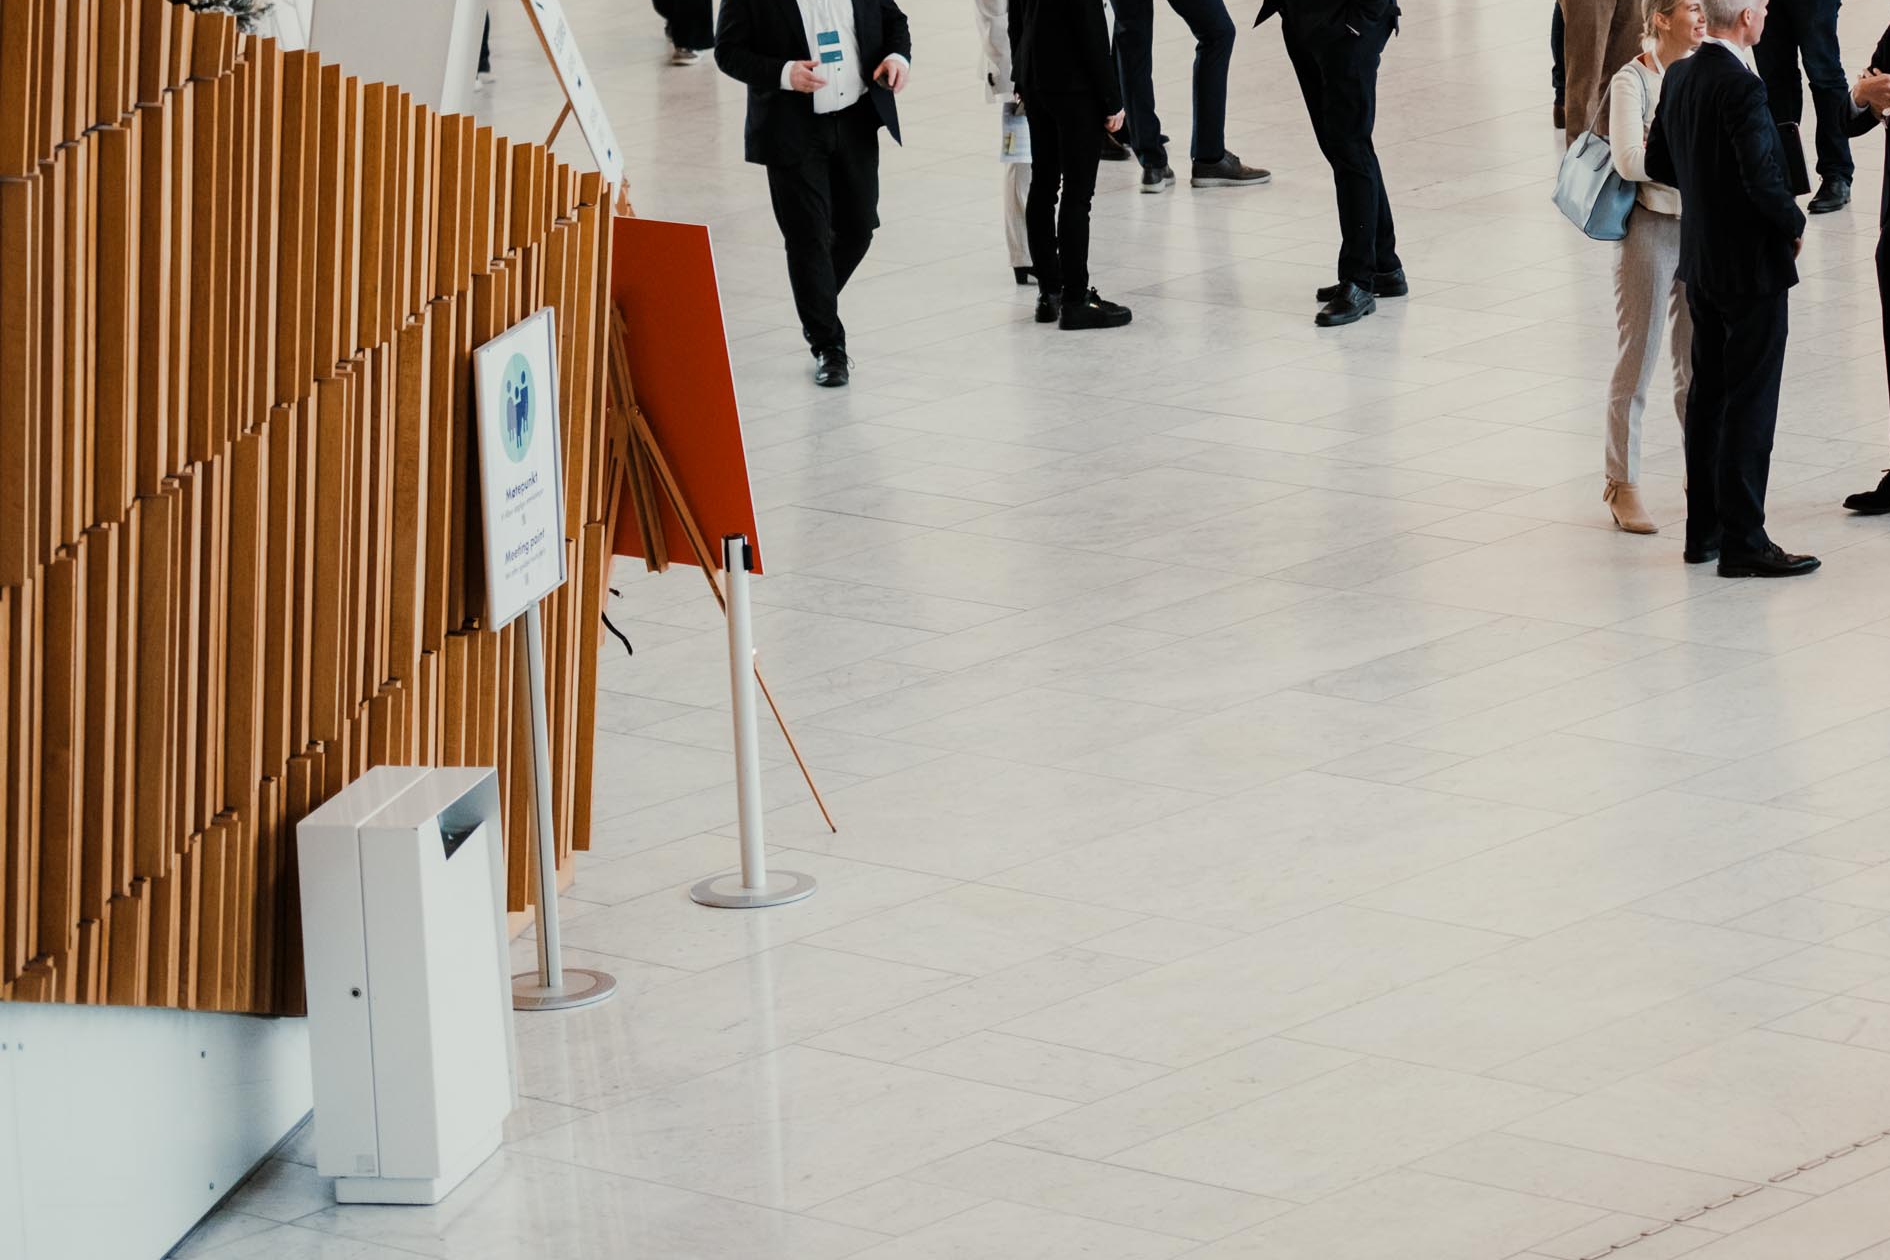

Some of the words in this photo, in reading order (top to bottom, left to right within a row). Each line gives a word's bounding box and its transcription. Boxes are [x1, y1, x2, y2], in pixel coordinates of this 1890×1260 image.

[505, 471, 538, 501] Møtepunkt
[504, 539, 530, 565] Meeting
[530, 527, 545, 551] point
